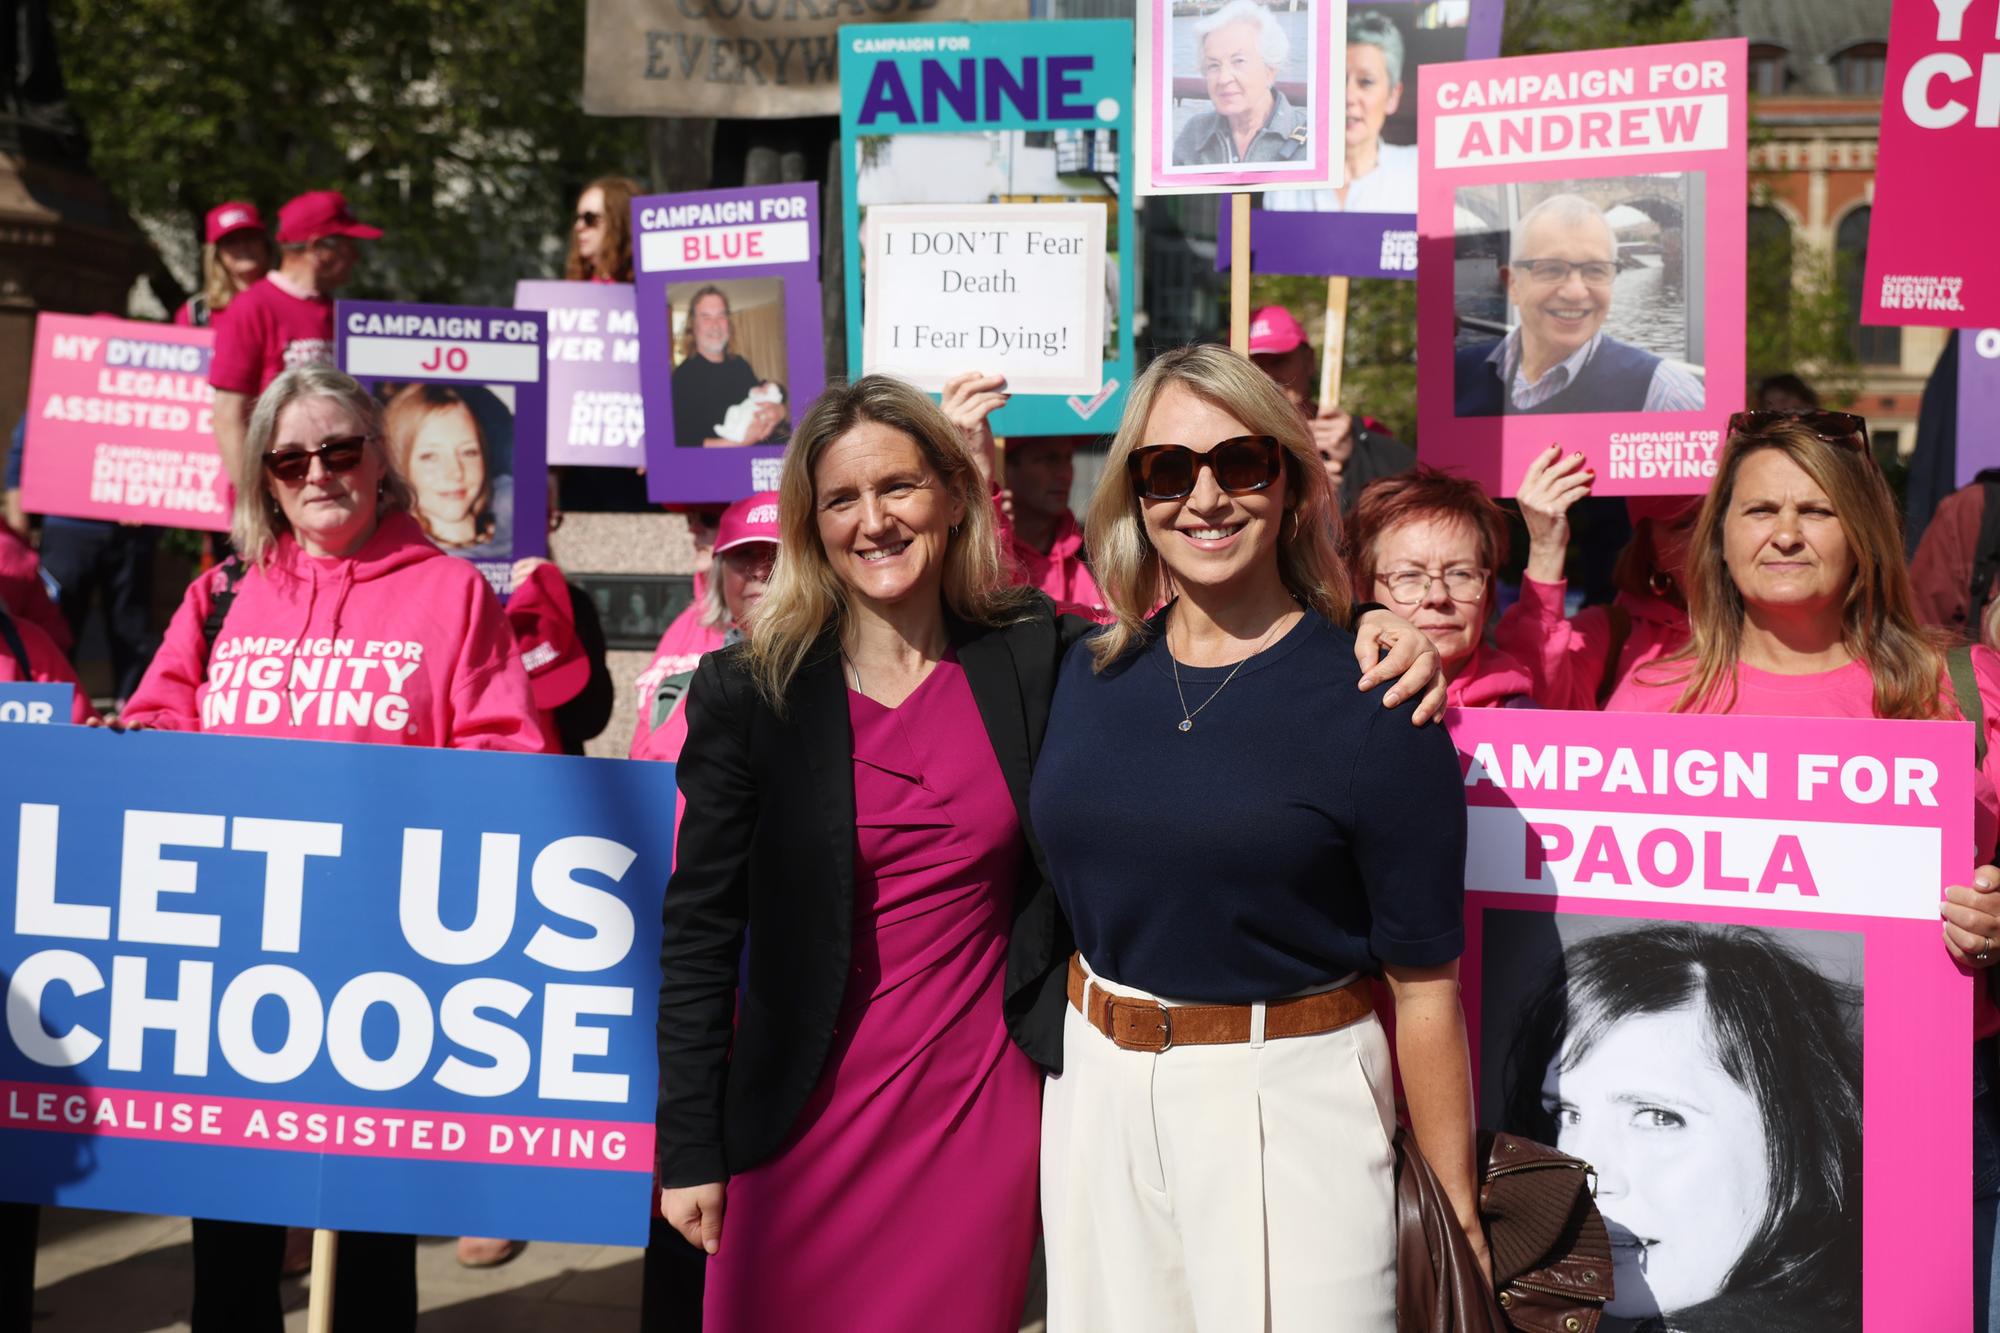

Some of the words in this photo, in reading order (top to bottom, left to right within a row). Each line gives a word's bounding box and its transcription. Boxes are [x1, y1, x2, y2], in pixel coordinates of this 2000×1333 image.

[1932, 0, 2000, 41] Y
[853, 38, 934, 52] CAMPAIGN
[938, 36, 970, 51] FOR
[1437, 68, 1634, 109] CAMPAIGN
[1649, 61, 1726, 92] FOR
[1457, 104, 1704, 159] ANDREW
[640, 200, 754, 230] CAMPAIGN
[760, 197, 807, 221] FOR
[683, 232, 763, 262] BLUE
[886, 232, 892, 255] I
[911, 232, 1008, 255] DON'T
[1026, 232, 1083, 255] Fear
[942, 269, 1016, 292] Death
[1882, 284, 1960, 299] DIGNITY
[1880, 297, 1900, 308] IN
[348, 313, 481, 339] CAMPAIGN
[489, 320, 538, 342] FOR
[893, 325, 900, 348] I
[913, 325, 968, 348] Fear
[979, 325, 1067, 356] Dying!
[53, 335, 98, 361] MY
[107, 339, 200, 371] DYING
[421, 346, 469, 372] JO
[43, 395, 190, 430] ASSISTED
[1609, 442, 1719, 461] DIGNITY
[1610, 431, 1685, 444] CAMPAIGN
[1690, 430, 1719, 442] FOR
[93, 459, 218, 489] DIGNITY
[1610, 461, 1635, 479] IN
[1639, 460, 1718, 478] DYING
[91, 482, 122, 503] IN
[125, 486, 224, 513] DYING.
[215, 636, 354, 660] CAMPAIGN
[364, 640, 424, 661] FOR
[209, 656, 419, 693] DIGNITY
[202, 691, 239, 729] IN
[1457, 742, 1767, 799] AMPAIGN
[1798, 753, 1939, 807] FOR
[1525, 822, 1820, 897] PAOLA
[14, 803, 343, 953] LET
[399, 827, 637, 973] US
[6, 949, 634, 1103] CHOOSE
[10, 1091, 222, 1135] LEGALISE
[245, 1110, 466, 1152] ASSISTED
[489, 1125, 626, 1161] DYING
